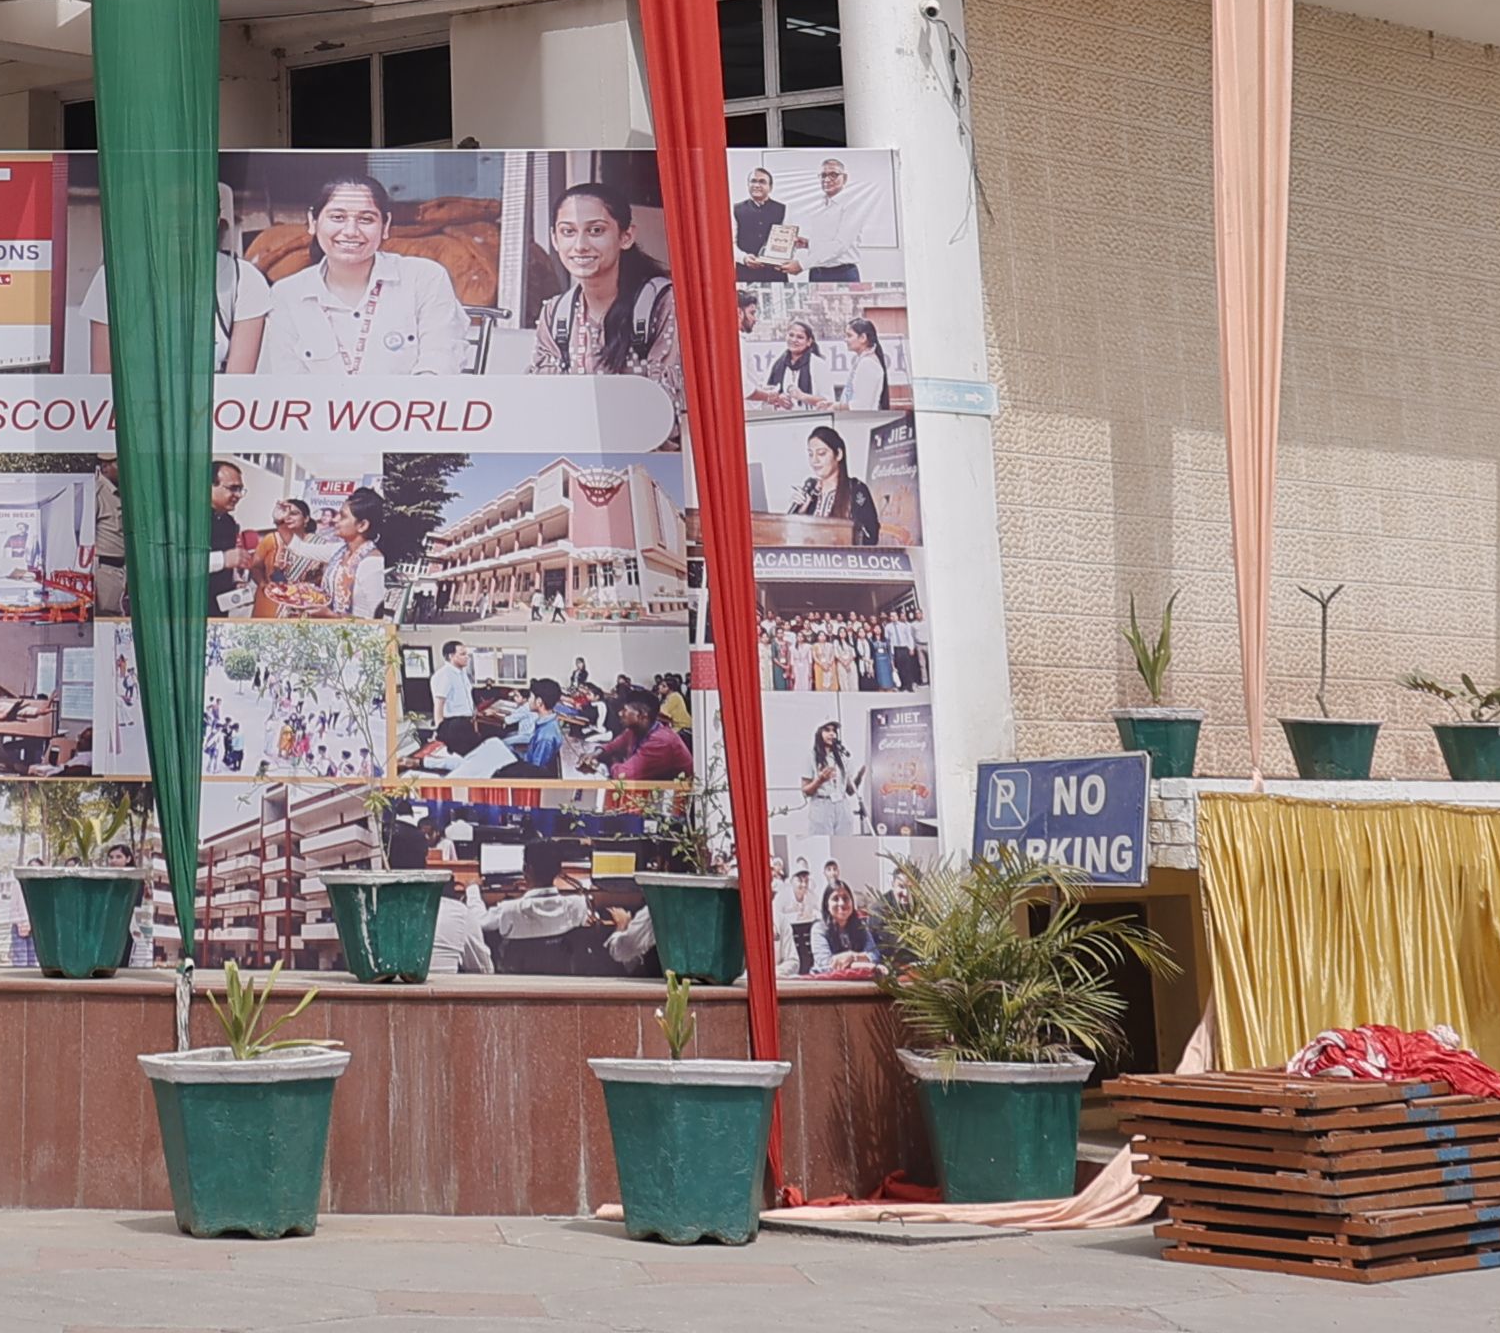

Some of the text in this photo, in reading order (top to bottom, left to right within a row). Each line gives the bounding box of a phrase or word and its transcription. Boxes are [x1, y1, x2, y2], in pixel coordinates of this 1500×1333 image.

[327, 399, 493, 432] WORLD
[753, 552, 902, 570] ACADEMIC BLOCK
[892, 712, 921, 724] JIET
[1052, 774, 1106, 816] NO
